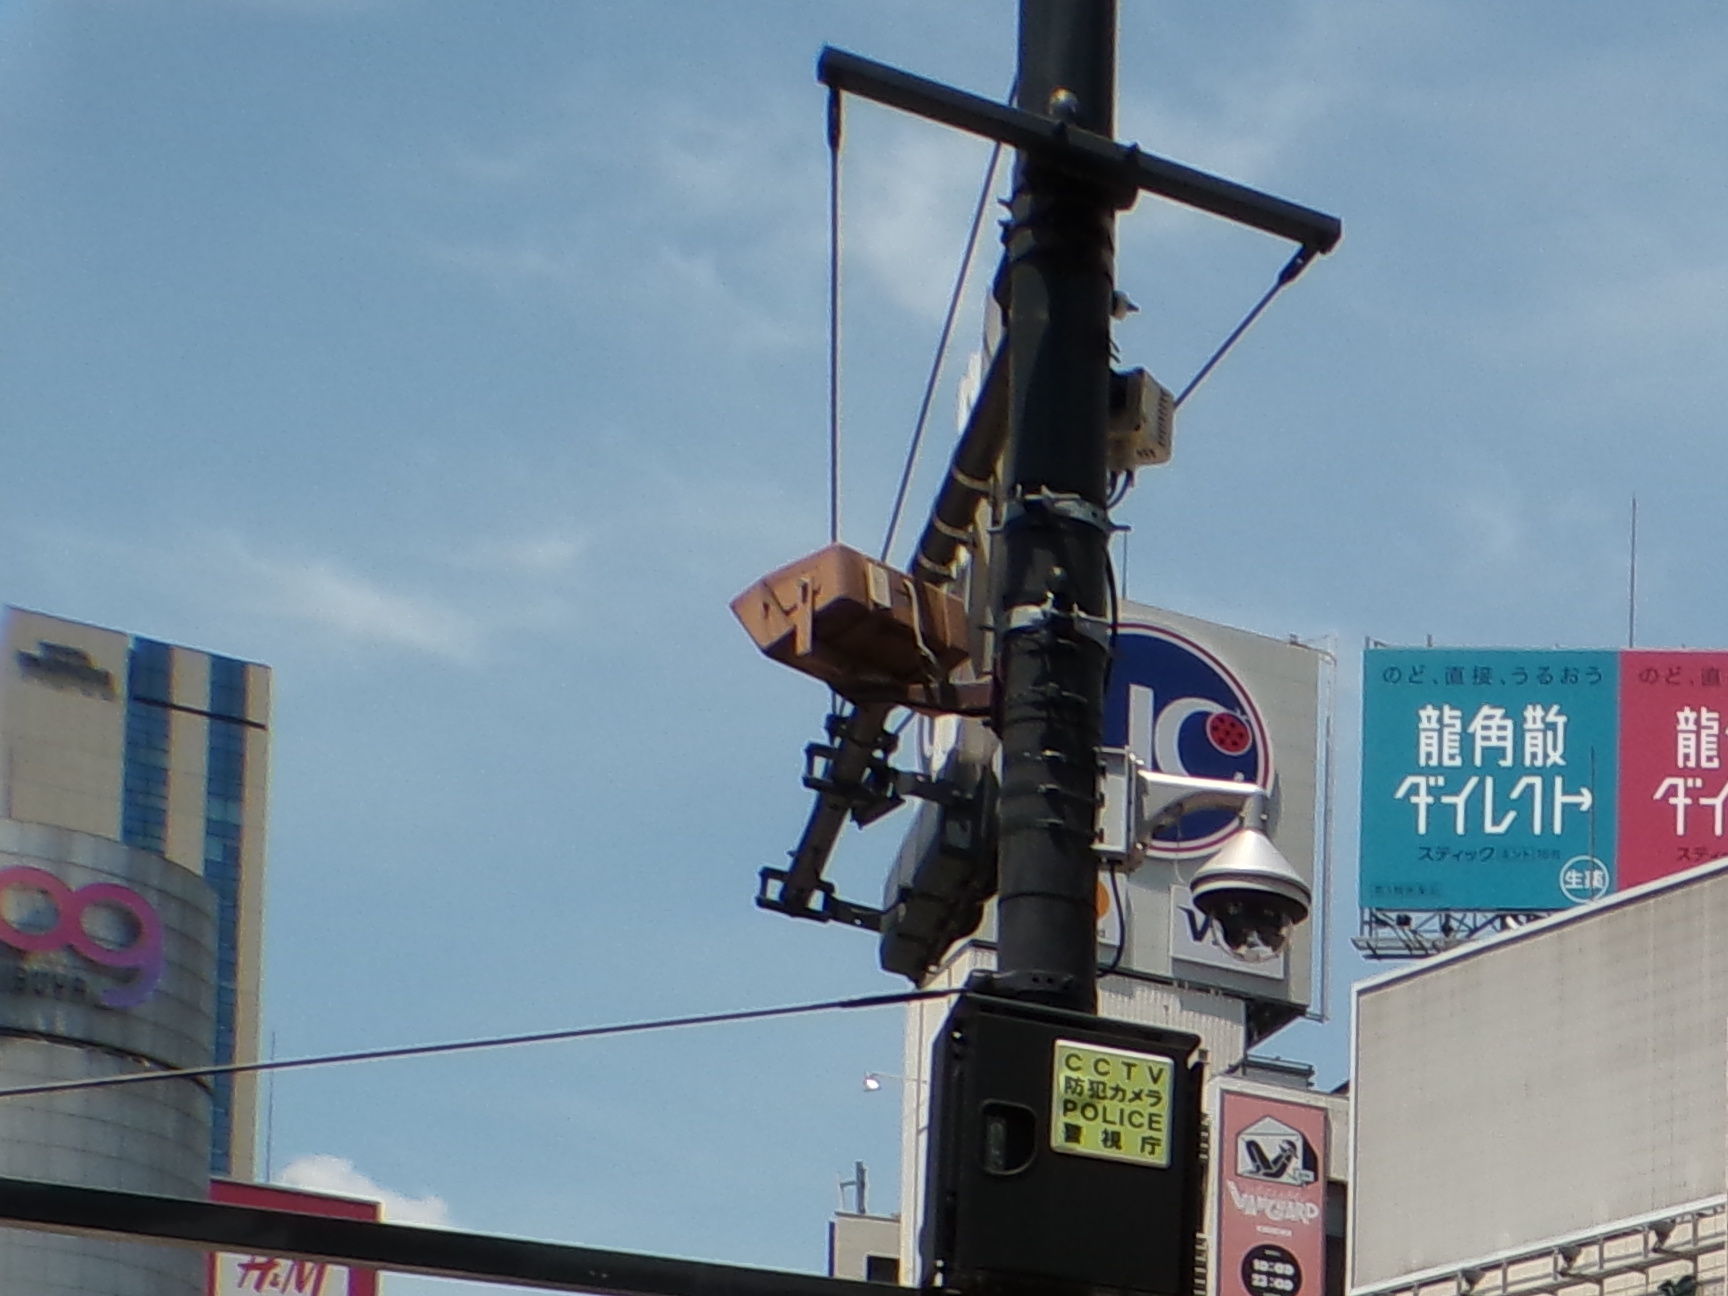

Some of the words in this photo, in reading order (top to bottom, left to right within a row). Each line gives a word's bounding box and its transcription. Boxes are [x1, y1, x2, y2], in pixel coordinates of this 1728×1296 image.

[1382, 664, 1603, 687] のど、直接、うるおう
[1418, 702, 1568, 768] 龍角散
[1394, 774, 1594, 835] ダイレクト
[1065, 1053, 1164, 1085] CCTV
[1064, 1075, 1163, 1107] 防犯カメラ
[1063, 1099, 1163, 1132] POLICE
